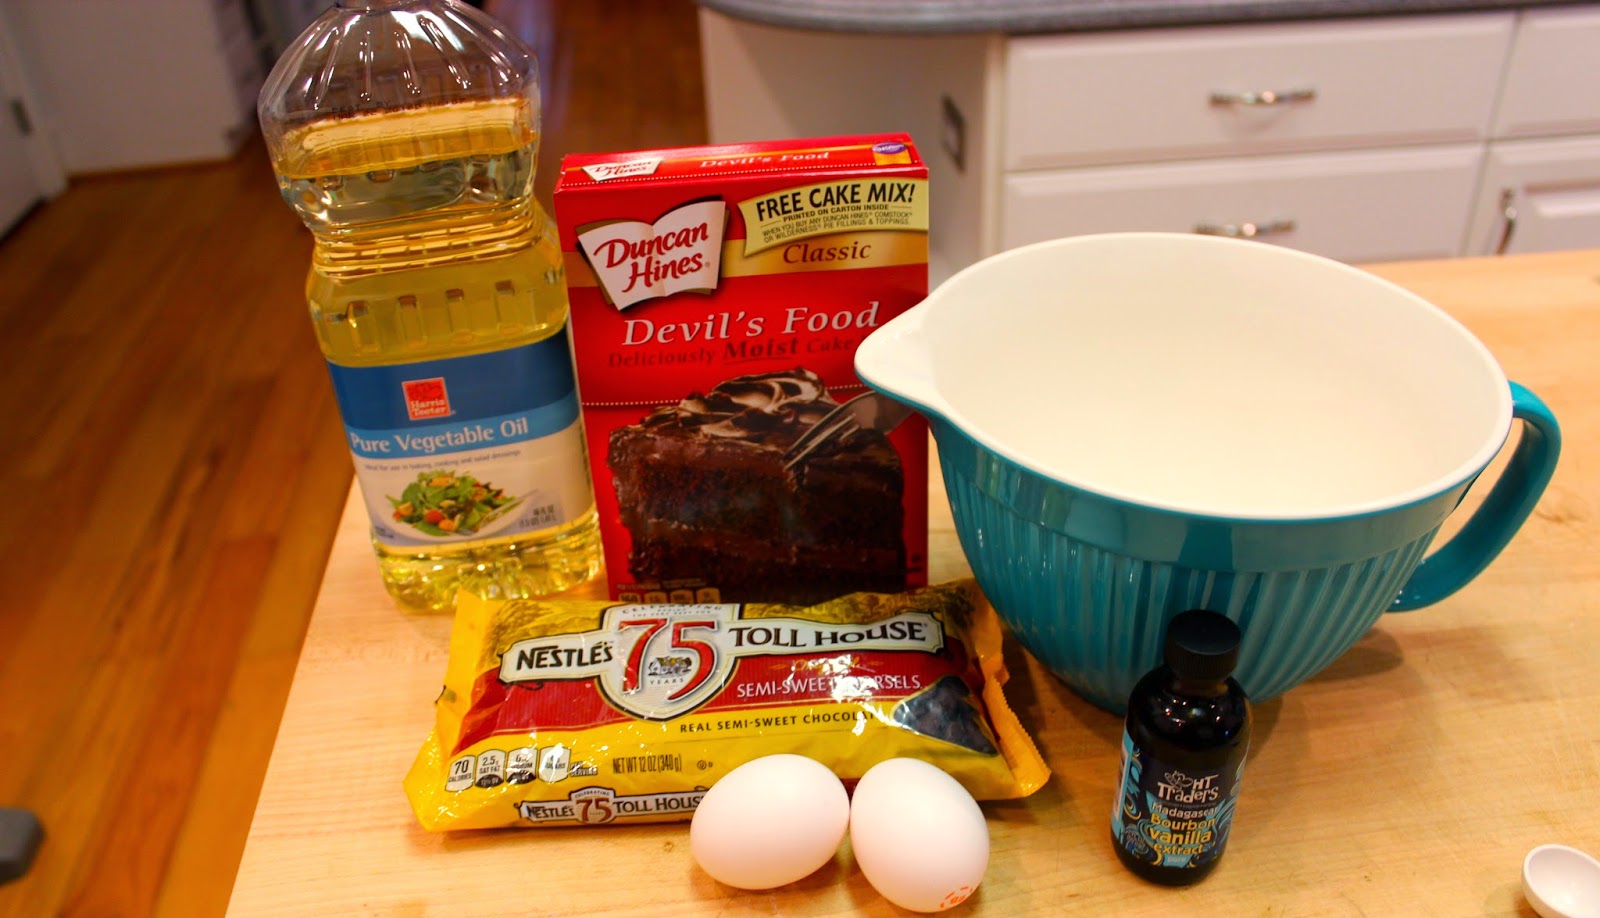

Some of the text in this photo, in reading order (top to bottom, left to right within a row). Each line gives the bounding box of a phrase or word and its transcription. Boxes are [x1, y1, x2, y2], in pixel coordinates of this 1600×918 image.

[700, 152, 830, 168] Devil's Food
[756, 183, 916, 222] FREE CAKE MIX!
[783, 210, 816, 222] PRINTED
[830, 204, 862, 214] CARTON
[762, 226, 781, 236] WHEN
[782, 222, 795, 232] YOU
[795, 220, 808, 228] BUY
[808, 217, 822, 225] ANY
[822, 214, 850, 223] DUNCAN
[764, 236, 774, 244] OR
[824, 221, 834, 229] PIE
[836, 219, 866, 228] FILLINGS
[593, 222, 708, 268] Duncan
[783, 241, 872, 264] Classic
[622, 252, 704, 292] Hines
[622, 300, 880, 346] Devil's Food
[608, 338, 854, 368] Deliciously Moist Cake
[410, 398, 445, 410] Harris
[412, 407, 447, 417] Teeter
[350, 416, 529, 453] Pure Vegetable Oil
[618, 618, 716, 700] 75
[728, 627, 807, 648] TOLL
[814, 621, 926, 646] HOUSE
[680, 711, 876, 733] REAL SEMI-SWEET CHOCOLAT
[454, 760, 470, 774] 70
[479, 765, 500, 774] SAT FAT
[613, 758, 625, 774] NET
[626, 757, 637, 773] WT
[639, 756, 646, 772] 12
[648, 756, 657, 772] OZ
[1192, 774, 1220, 790] HT
[574, 790, 610, 798] CELEBRATING
[1158, 782, 1219, 803] Traders
[576, 797, 612, 823] 75
[612, 802, 652, 814] TOLL
[656, 796, 704, 811] HOUS
[1152, 802, 1218, 820] Madagascar
[1150, 812, 1215, 831] Bourbon
[1150, 828, 1212, 845] vanilla
[1154, 844, 1203, 855] extract
